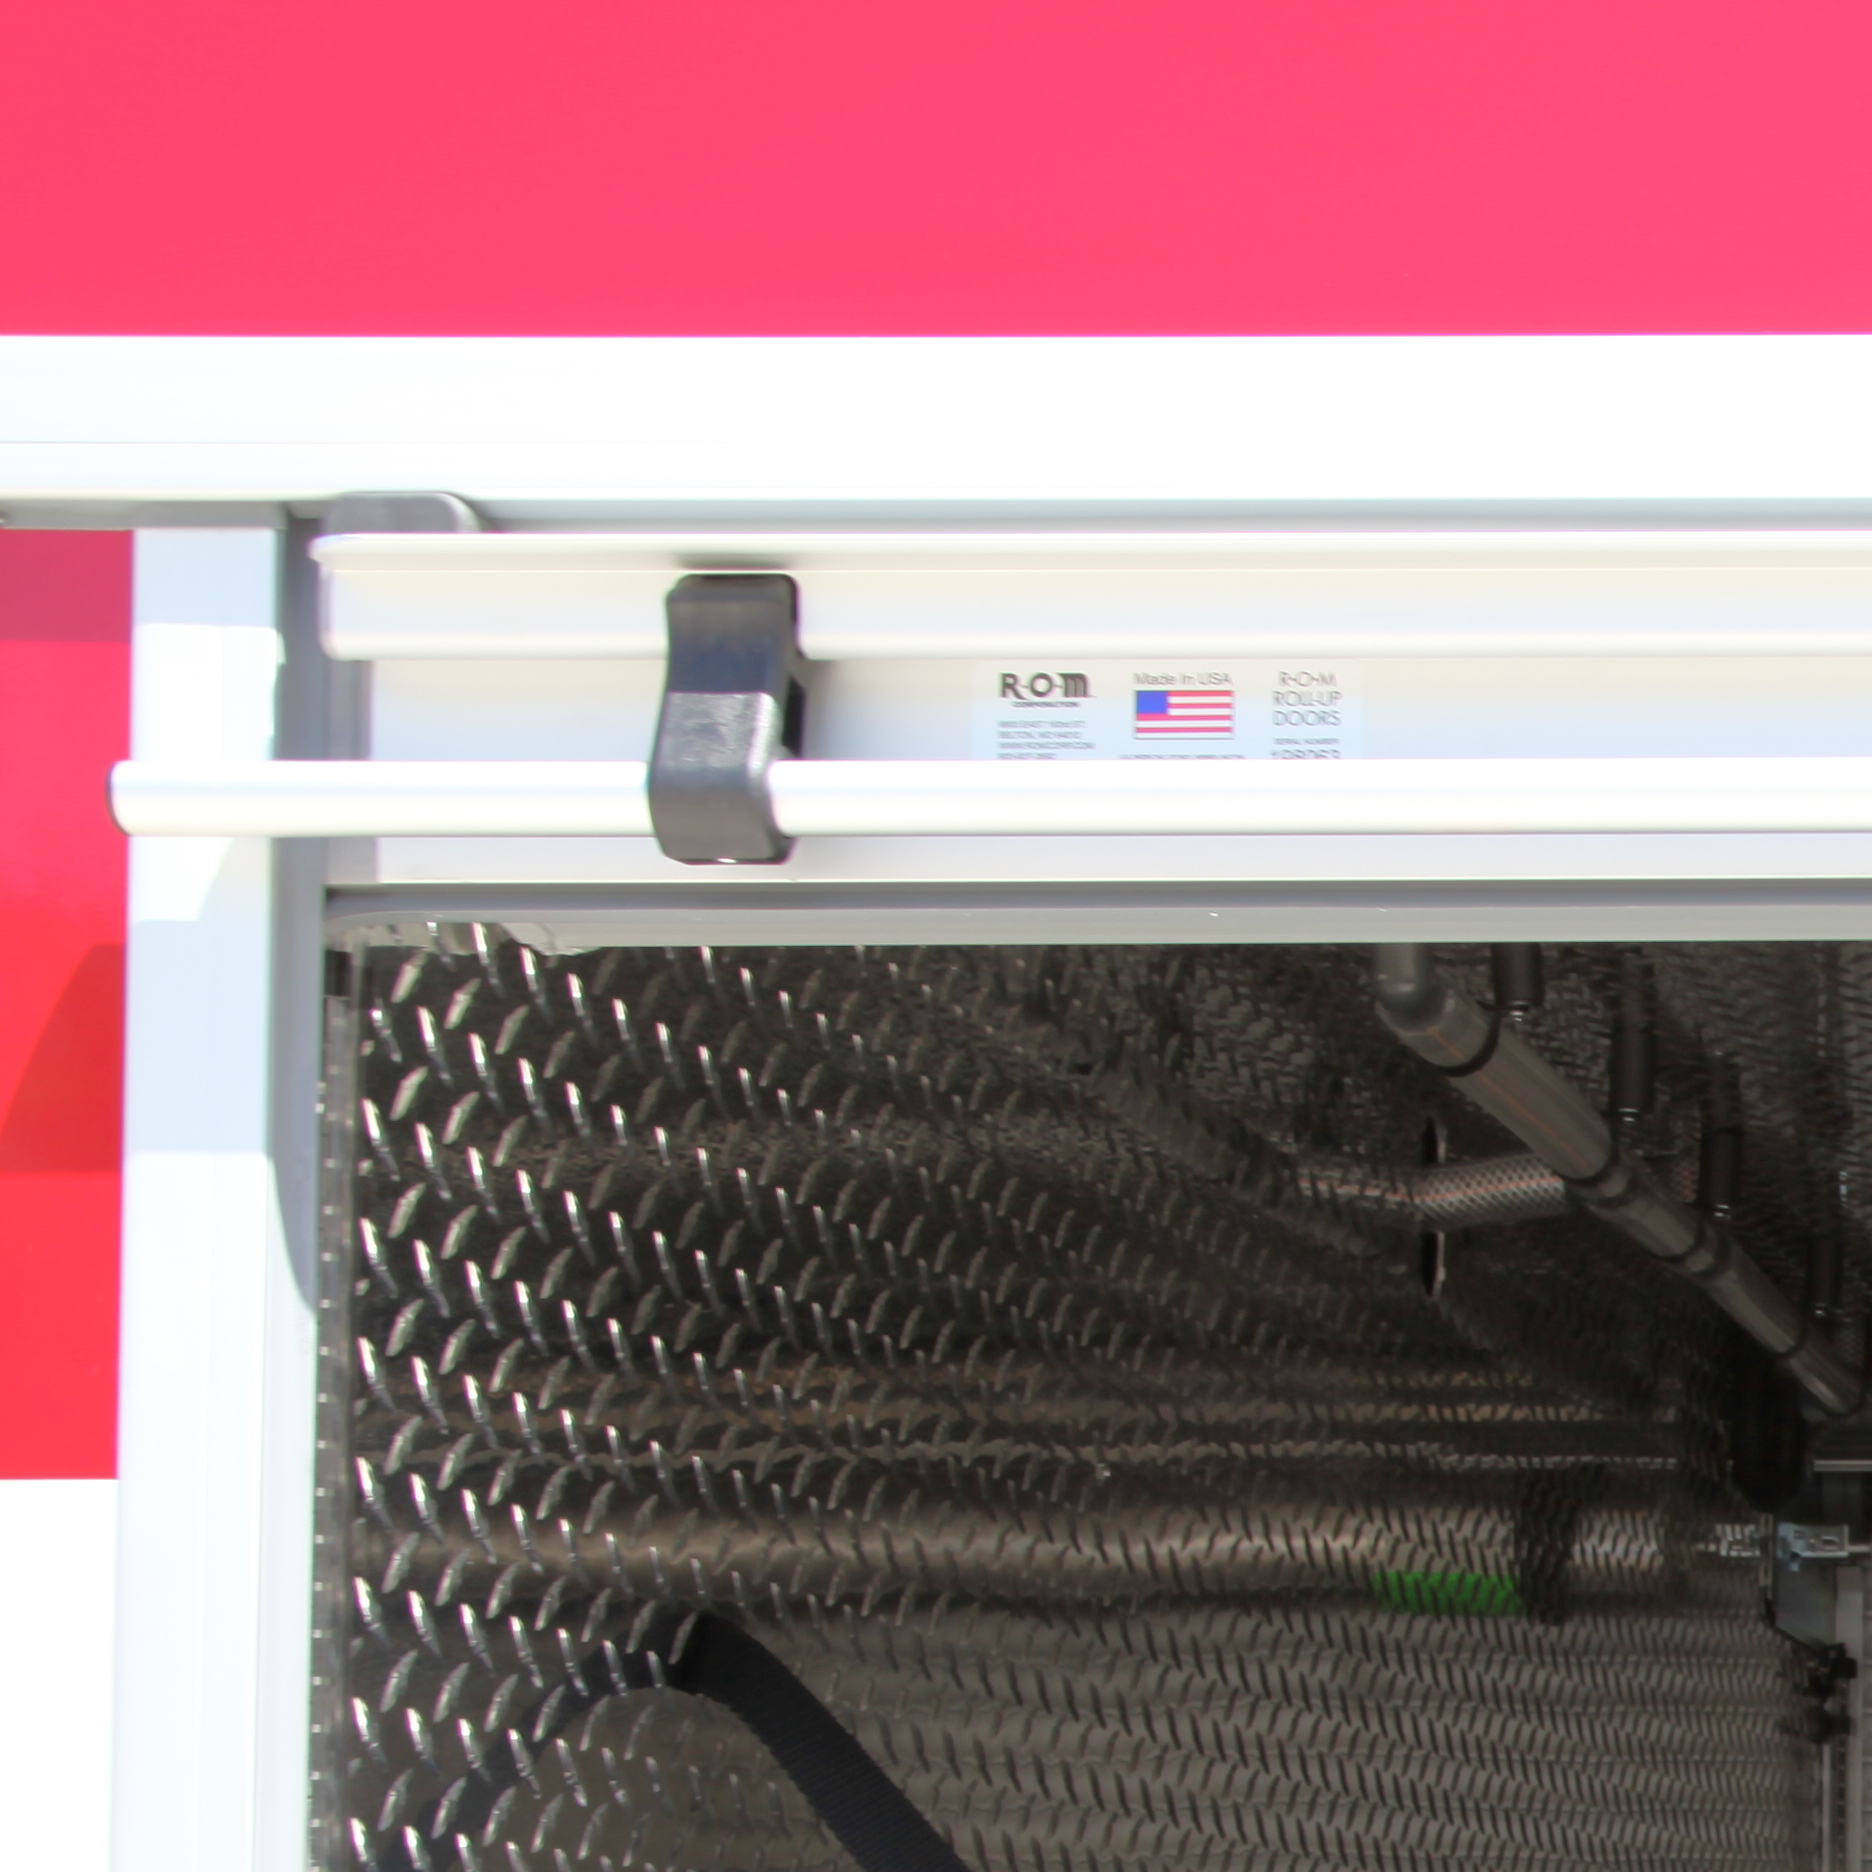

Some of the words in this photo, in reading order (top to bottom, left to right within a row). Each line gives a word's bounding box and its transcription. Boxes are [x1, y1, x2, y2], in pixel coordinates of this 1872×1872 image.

[1132, 671, 1177, 686] Made
[1197, 671, 1234, 686] USA
[1271, 690, 1344, 707] ROLL-UP
[1271, 709, 1342, 727] DOORS
